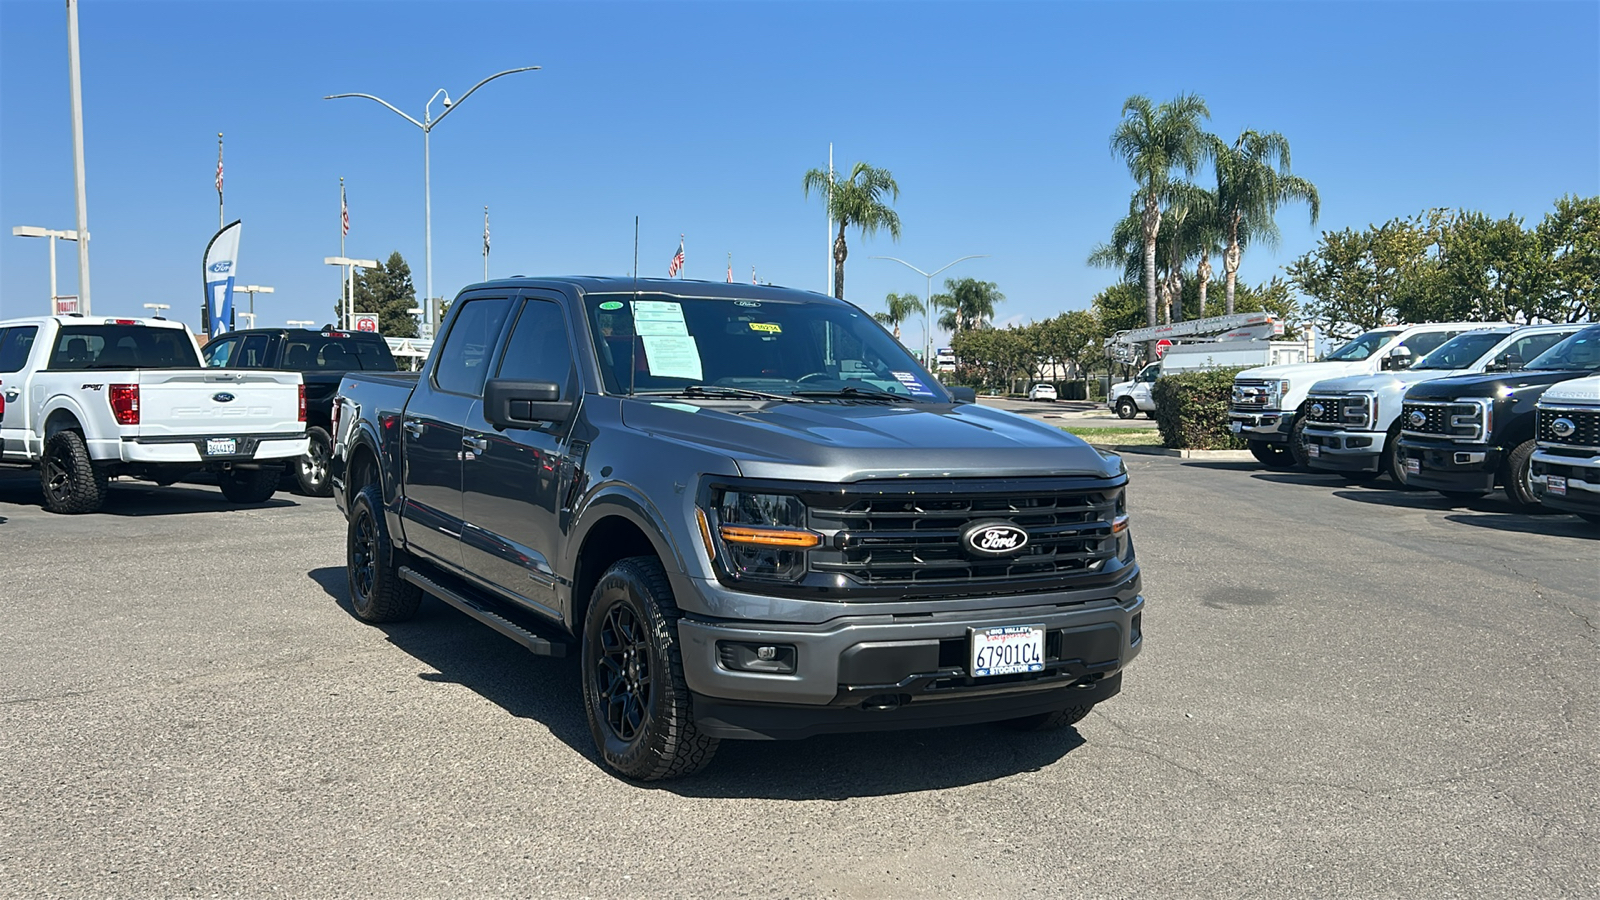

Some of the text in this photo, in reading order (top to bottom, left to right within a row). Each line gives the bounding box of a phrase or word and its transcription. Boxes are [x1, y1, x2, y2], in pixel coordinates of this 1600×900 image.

[171, 406, 273, 418] F-150
[981, 530, 1018, 549] Ford
[1004, 626, 1029, 634] VALLEY
[976, 642, 1040, 668] 67901C4
[989, 664, 1029, 675] STOCKTON
